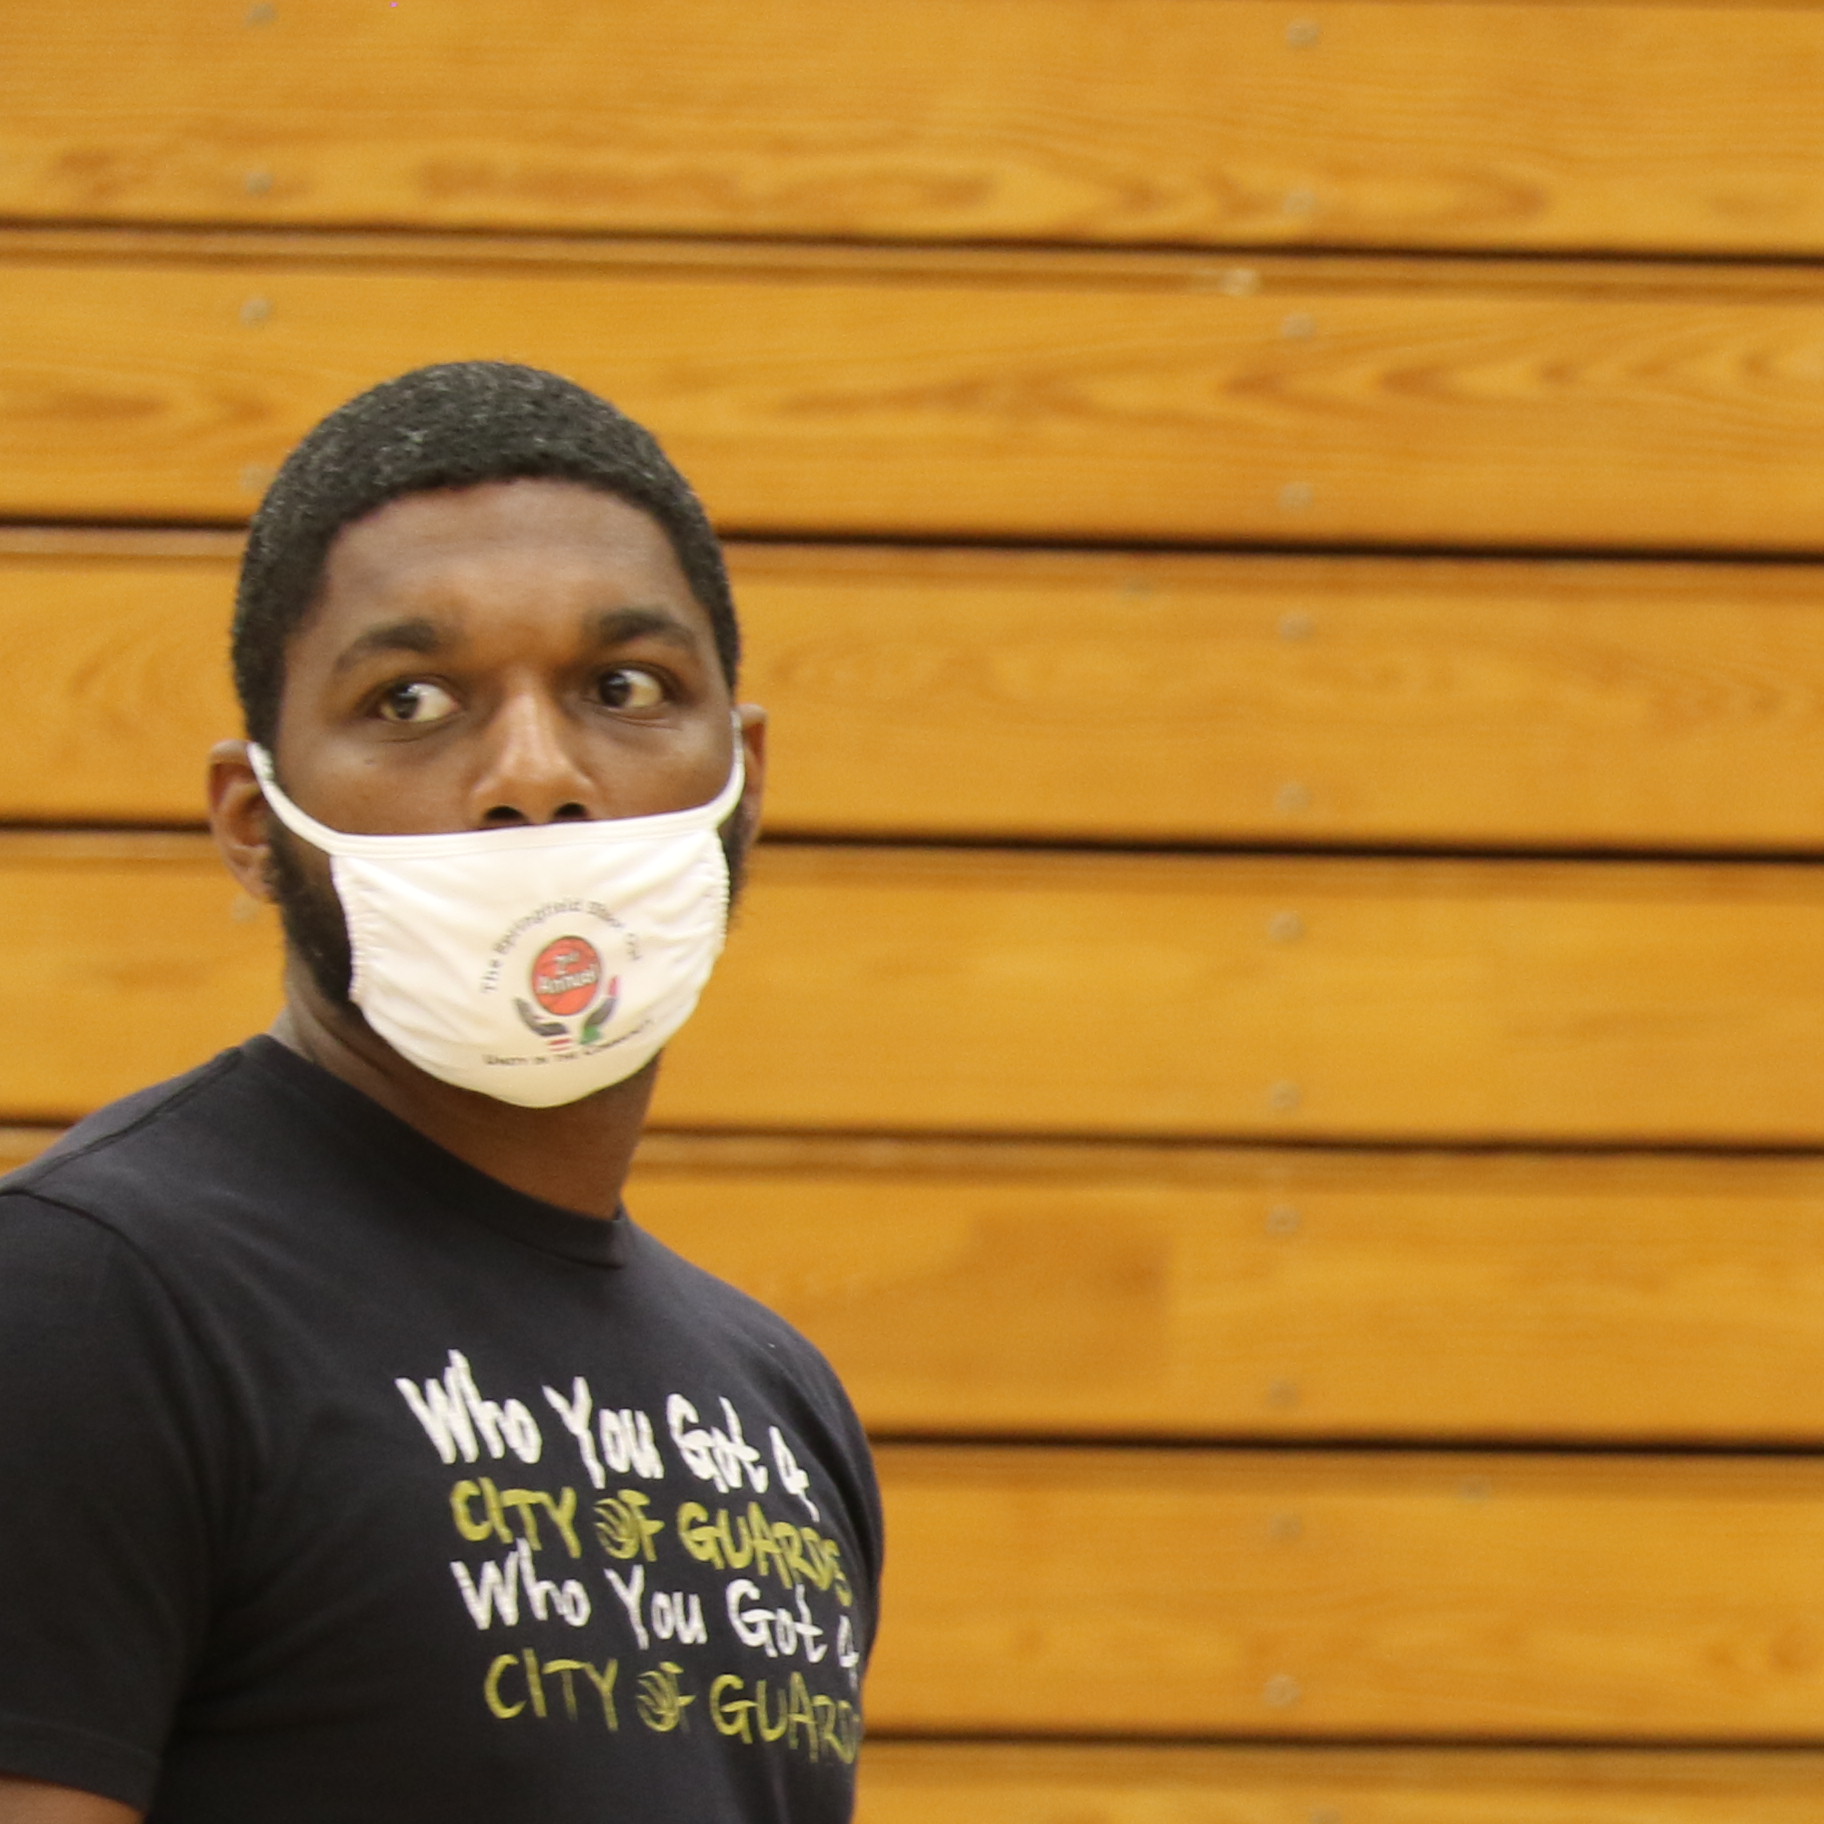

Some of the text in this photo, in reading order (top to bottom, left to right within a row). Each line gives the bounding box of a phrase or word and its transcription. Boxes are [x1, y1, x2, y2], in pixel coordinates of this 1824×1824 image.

[395, 1349, 542, 1464] Who
[542, 1376, 664, 1489] You
[667, 1393, 768, 1494] Got
[450, 1477, 852, 1606] CITY OF GUARDS
[450, 1538, 591, 1630] Who
[605, 1564, 707, 1650] You
[726, 1579, 828, 1663] Got
[484, 1648, 619, 1732] CITY
[709, 1672, 862, 1764] GUARD
